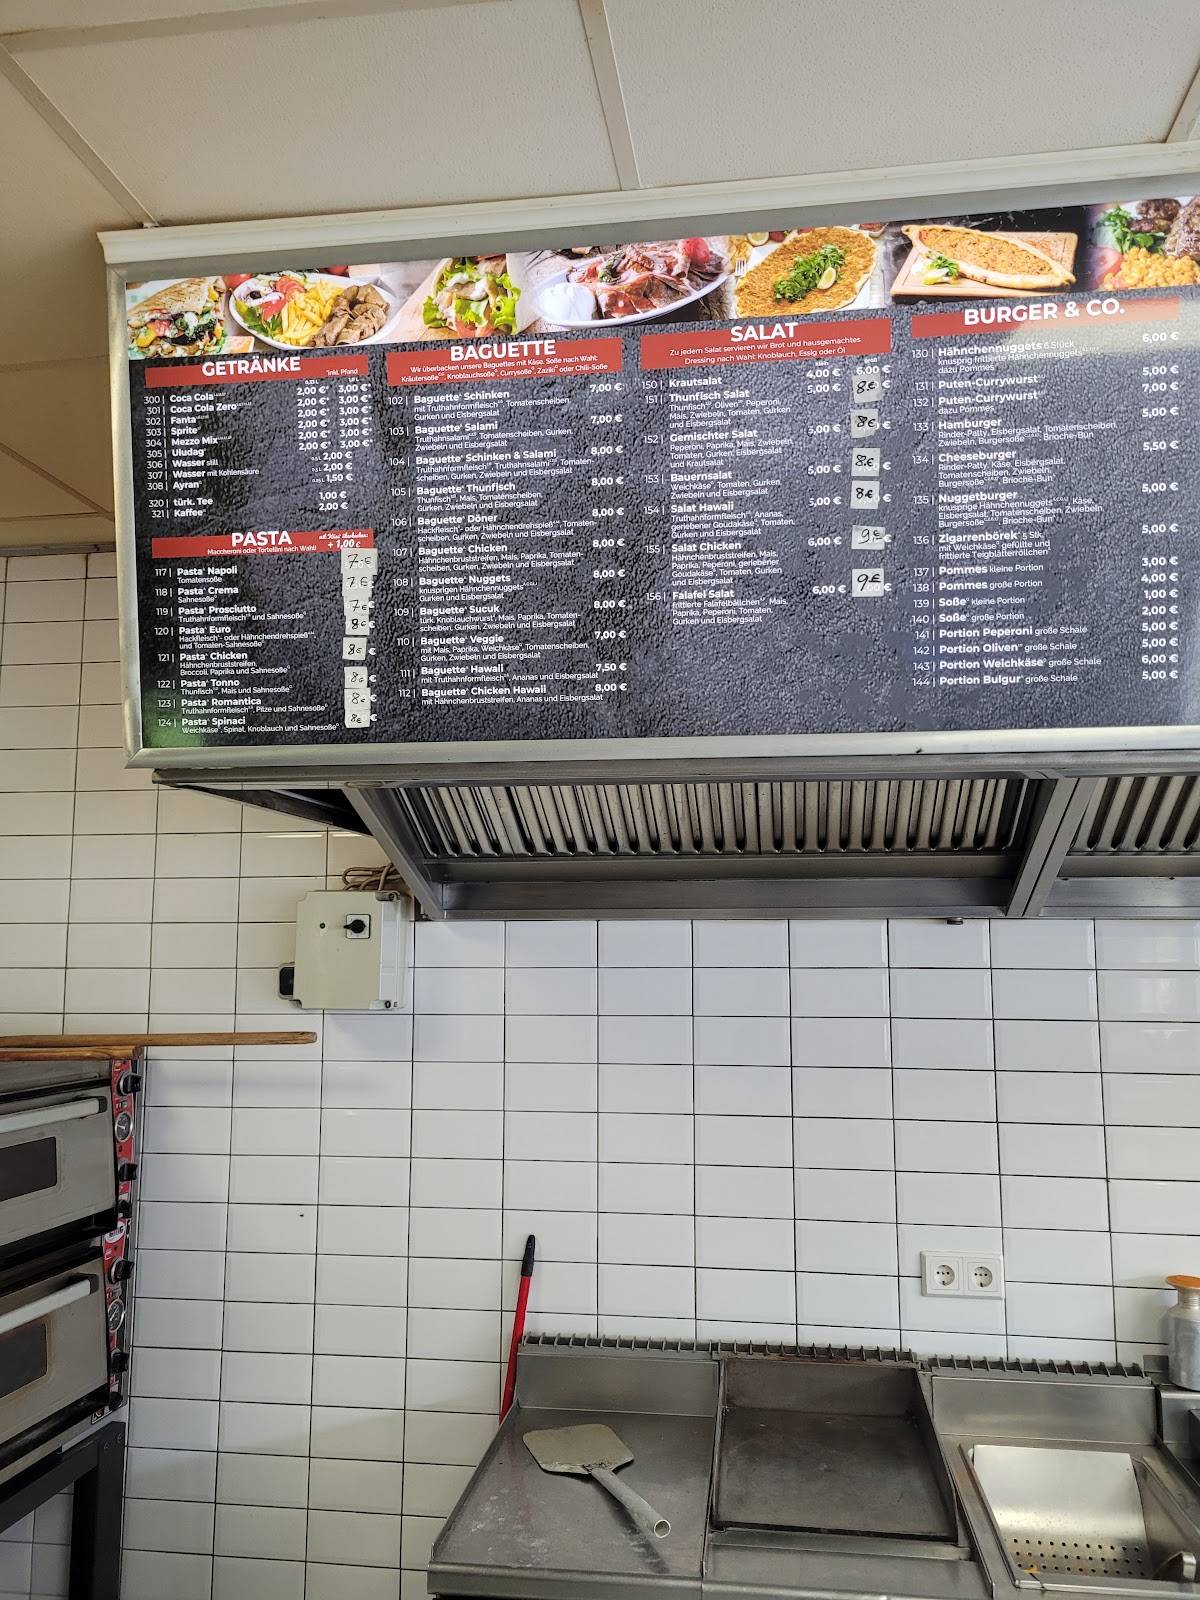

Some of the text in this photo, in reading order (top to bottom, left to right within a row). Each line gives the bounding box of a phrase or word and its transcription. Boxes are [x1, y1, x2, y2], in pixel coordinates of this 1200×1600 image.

[964, 299, 1124, 326] BURGER & CO.
[730, 322, 798, 342] SALAT
[803, 336, 861, 346] hausgemachtes
[939, 332, 1179, 356] Hähnchennuggets Stück 6,00 €
[450, 340, 556, 361] BAGUETTE
[685, 357, 715, 365] Dressing
[758, 351, 796, 360] Knoblauch,
[799, 349, 817, 358] Essig
[202, 356, 301, 376] GETRÄNKE
[423, 364, 459, 372] überbacken
[484, 361, 514, 370] Baguettes
[669, 365, 890, 387] Krautsalat 4,00 € 6,00 €
[464, 391, 509, 400] Schinken
[590, 384, 611, 393] 7,00
[669, 383, 840, 402] Thunfisch Salat 5,00 €
[464, 421, 498, 431] Salami
[591, 415, 612, 424] 7,00
[939, 407, 1178, 431] Hamburger 5,00 €
[670, 429, 757, 442] Gemischter Salat
[416, 443, 447, 452] Zwiebeln
[464, 440, 507, 449] Eisbergsalat
[939, 441, 1178, 464] Cheeseburger 5,50 €
[172, 459, 205, 468] Wasser
[323, 452, 342, 460] 2,00
[466, 452, 511, 462] Schinken
[523, 449, 556, 460] Salami
[591, 447, 613, 455] 8,00
[173, 470, 205, 479] Wasser
[324, 463, 342, 471] 2,00
[326, 474, 343, 482] 1,50
[670, 471, 732, 482] Bauernsalat
[467, 482, 515, 491] Thunfisch
[592, 478, 613, 486] 8,00
[319, 492, 337, 500] 1,00
[939, 491, 1017, 503] Nuggetburger
[671, 502, 734, 513] Salat Hawaii
[468, 515, 497, 523] Döner
[1142, 523, 1178, 534] 5,00 €
[232, 531, 292, 547] PASTA
[468, 543, 507, 553] Chicken
[593, 539, 614, 547] 8,00
[672, 537, 842, 551] Salat Chicken 6,00 €
[207, 566, 237, 576] Napoli
[939, 556, 1178, 576] Pommes kleine Portion 3,00 €
[469, 574, 511, 584] Nuggets
[939, 573, 1178, 591] Pommes große Portion 4,00 €
[672, 590, 707, 599] Falafel
[709, 589, 734, 598] Salat
[812, 585, 835, 594] 6,00
[209, 605, 256, 614] Prosciutto
[469, 605, 499, 614] Sucuk
[594, 600, 615, 609] 8,00
[470, 634, 504, 645] Veggie
[595, 630, 616, 639] 7,00
[939, 625, 1088, 638] Portion Peperoni große Schale
[471, 664, 503, 673] Hawaii
[596, 663, 617, 672] 7,50
[210, 679, 240, 687] Tonno
[940, 670, 1178, 685] Portion große Schale 5,00 €
[471, 686, 510, 695] Chicken
[513, 685, 546, 693] Hawaii
[595, 683, 617, 692] 8,00
[211, 698, 262, 706] Romantica
[212, 717, 246, 727] Spinaci
